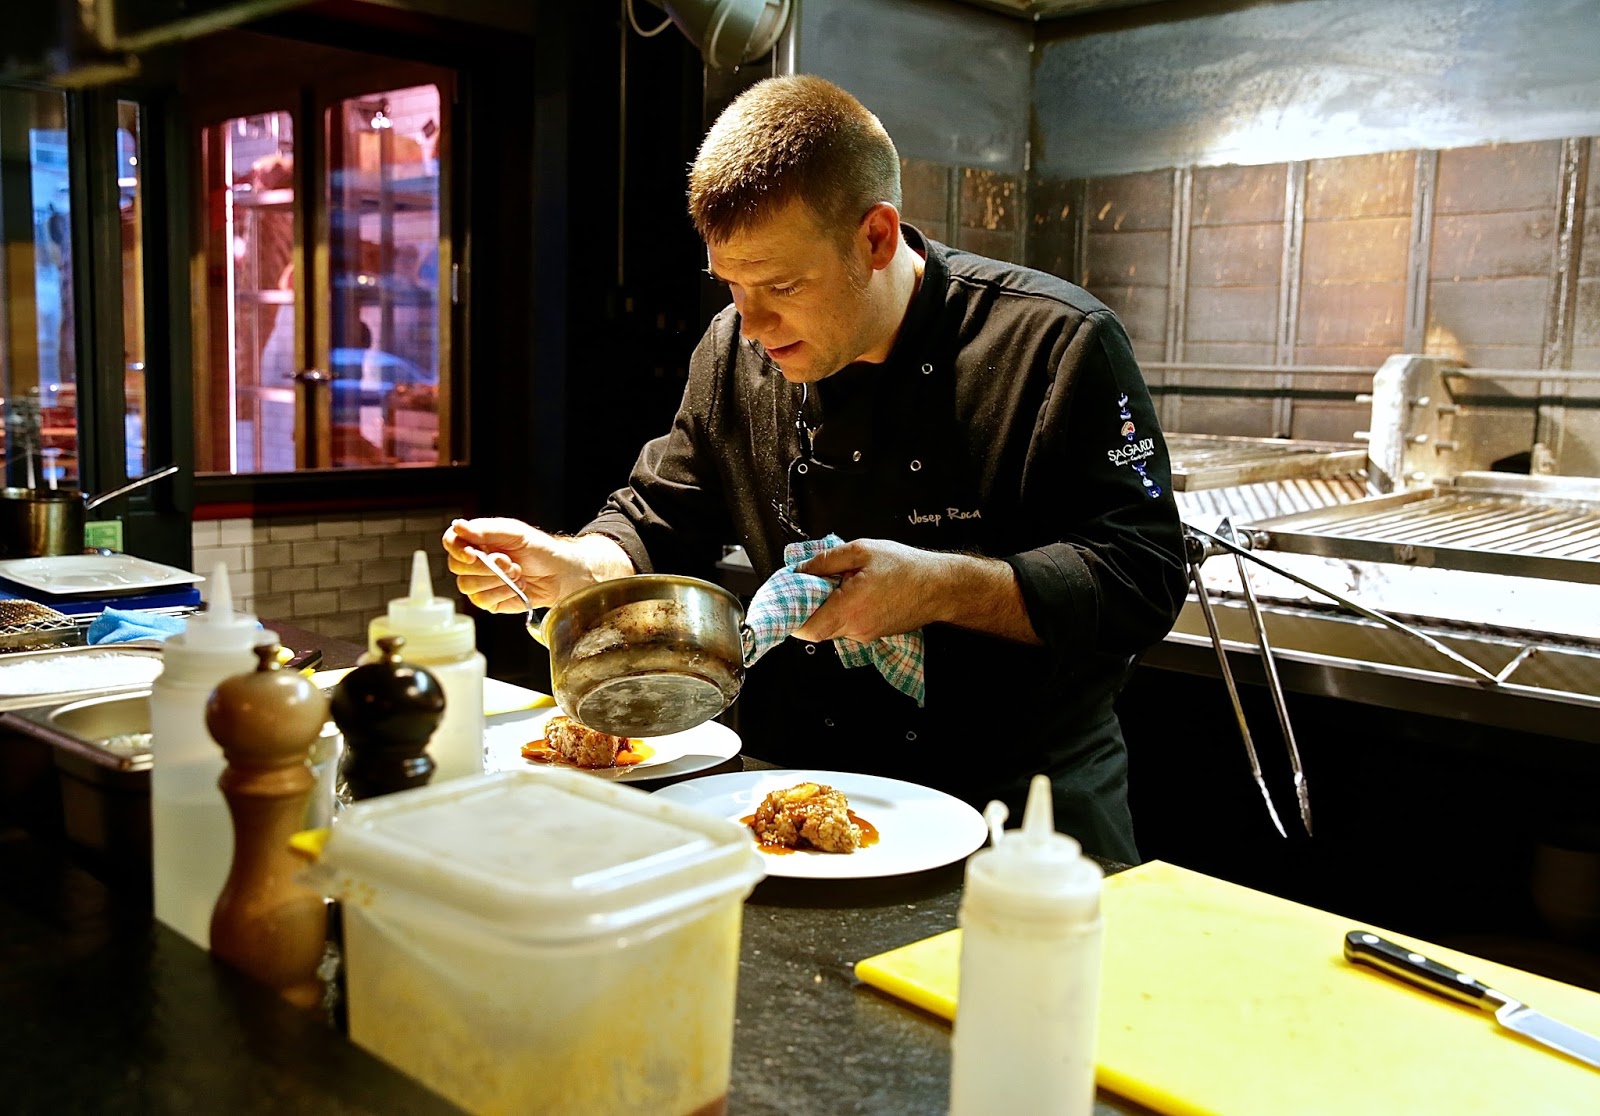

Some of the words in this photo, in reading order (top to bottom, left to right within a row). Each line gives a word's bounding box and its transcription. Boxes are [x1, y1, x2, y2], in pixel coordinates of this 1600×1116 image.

[1107, 438, 1155, 462] SAGARDI
[907, 508, 942, 527] Josep
[945, 507, 982, 520] Roca
